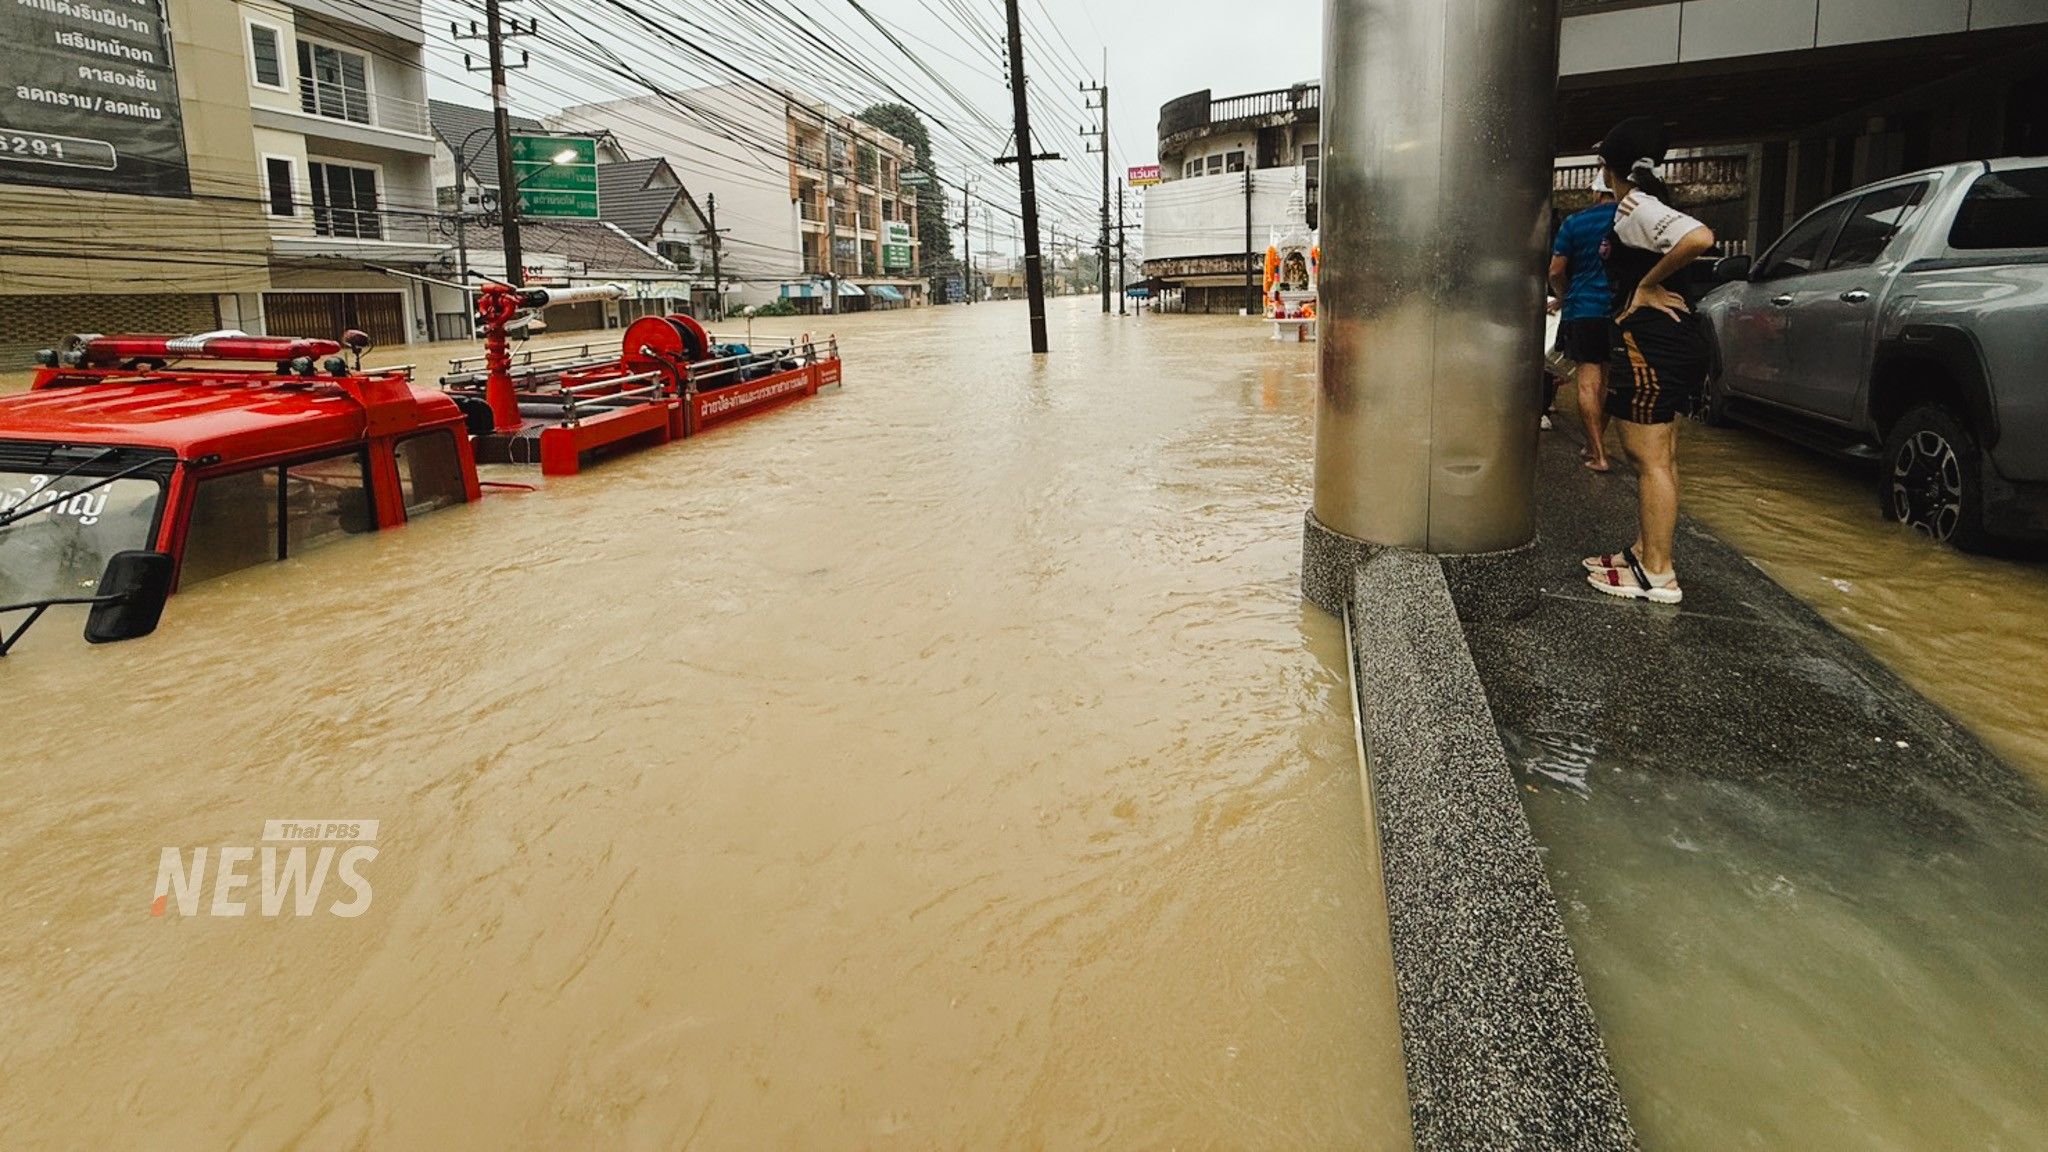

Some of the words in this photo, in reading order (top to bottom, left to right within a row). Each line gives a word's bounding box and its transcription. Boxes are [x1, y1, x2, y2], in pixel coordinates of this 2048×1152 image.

[55, 31, 154, 64] เสริมหน้าอก
[78, 65, 157, 92] ตาสองชั้น
